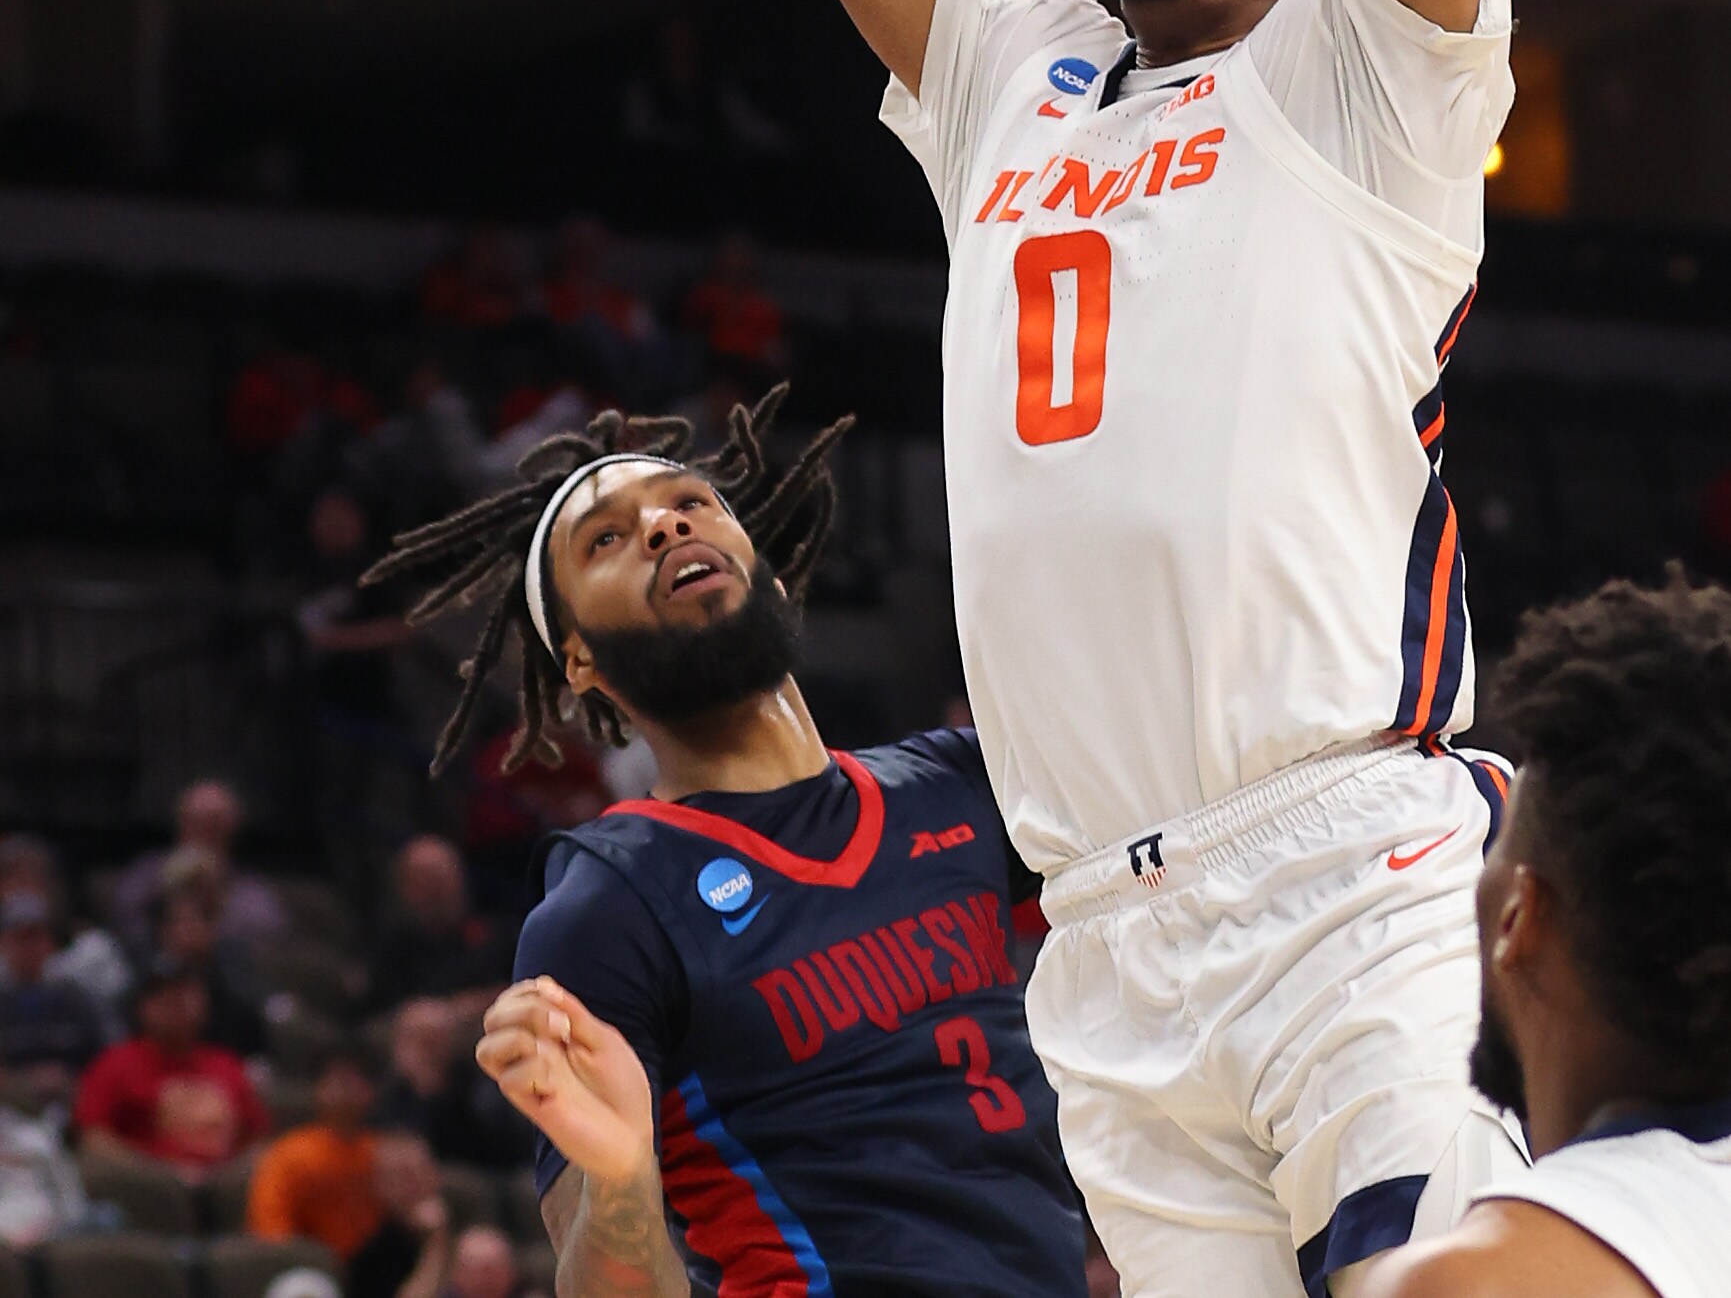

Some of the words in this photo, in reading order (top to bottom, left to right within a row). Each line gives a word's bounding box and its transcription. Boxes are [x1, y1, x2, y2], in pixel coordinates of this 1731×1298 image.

[1013, 229, 1113, 446] 0
[709, 873, 751, 905] NCAA
[934, 1016, 1026, 1133] 3
